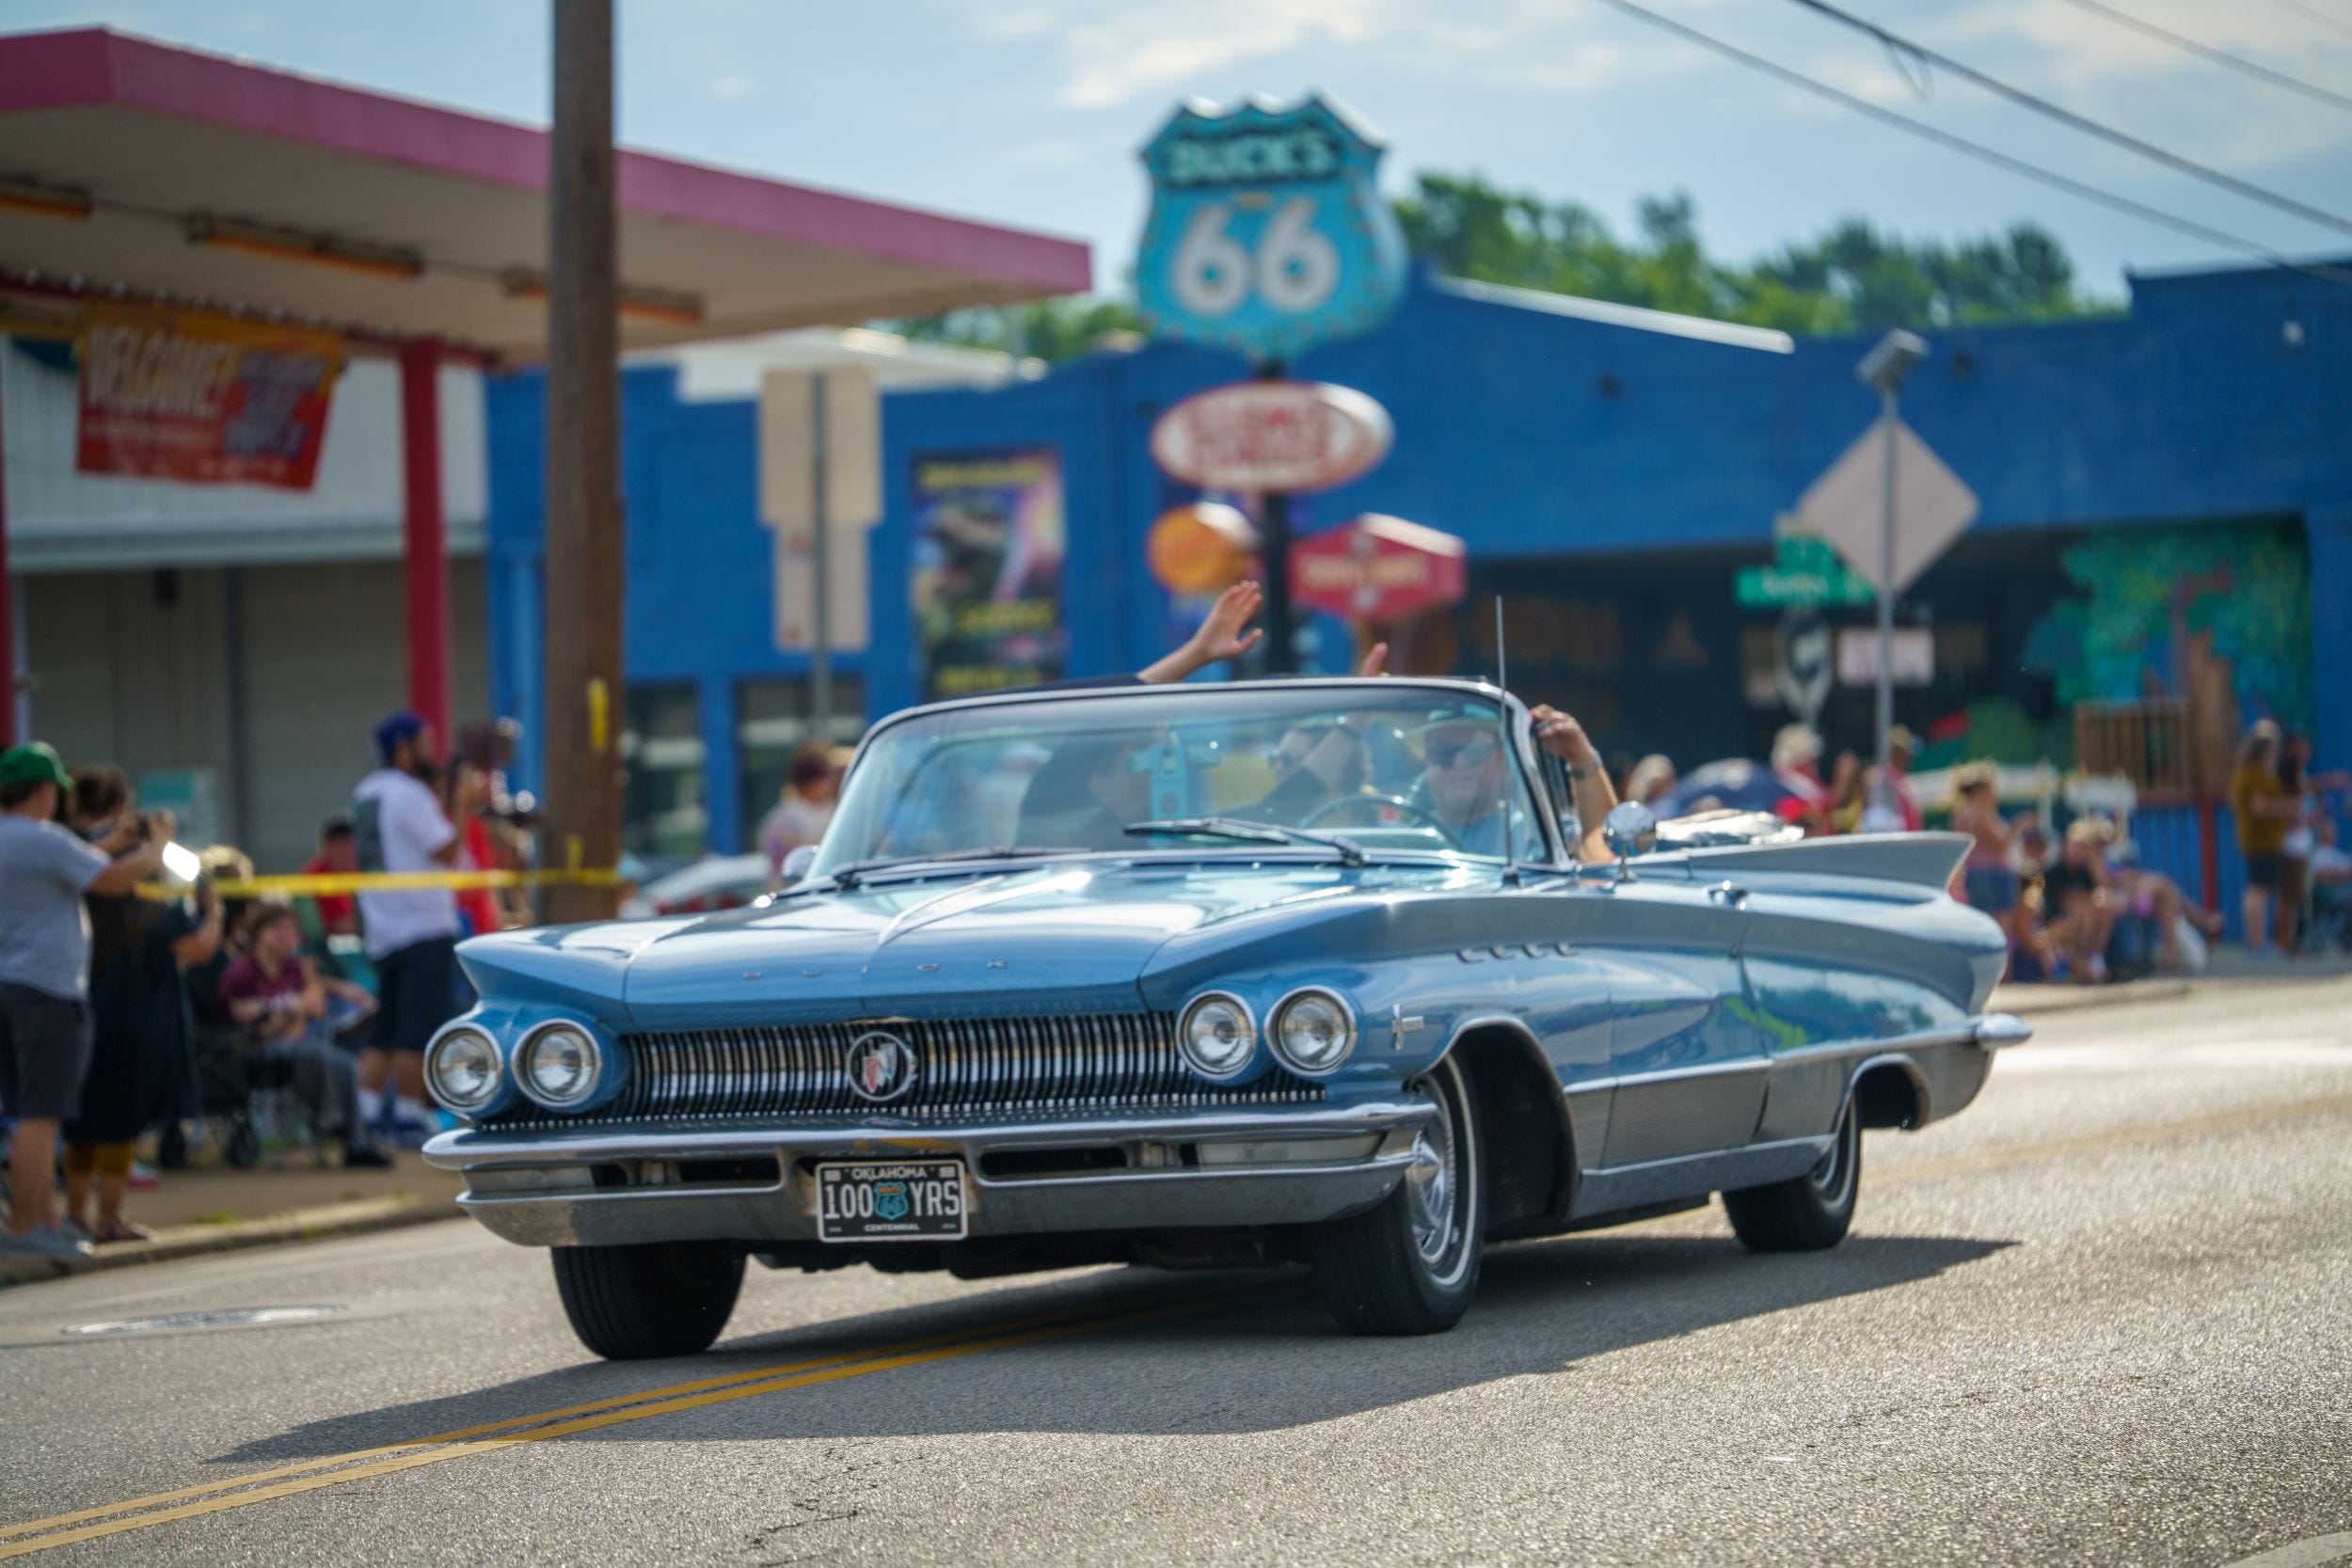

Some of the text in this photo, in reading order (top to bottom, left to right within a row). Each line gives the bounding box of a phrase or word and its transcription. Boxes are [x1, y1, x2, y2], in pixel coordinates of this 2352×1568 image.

[1173, 198, 1341, 316] 66
[851, 1166, 928, 1180] OKLAHOMA
[824, 1180, 961, 1220] 100 YRS
[864, 1224, 920, 1233] CENTENNIAL
